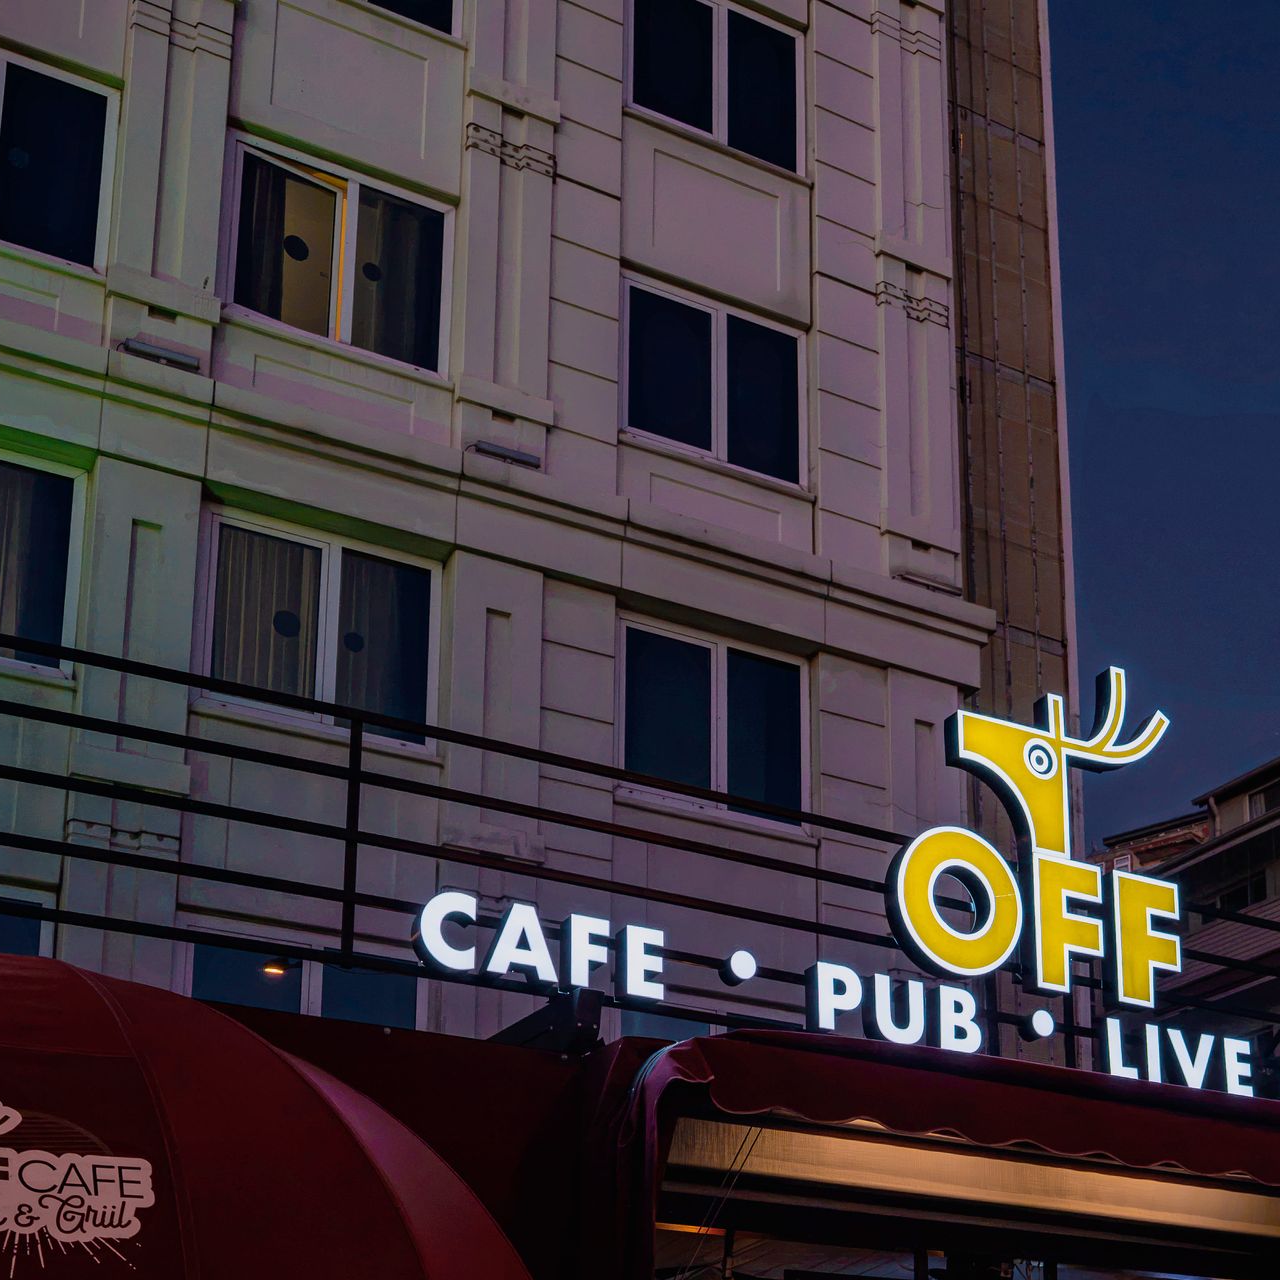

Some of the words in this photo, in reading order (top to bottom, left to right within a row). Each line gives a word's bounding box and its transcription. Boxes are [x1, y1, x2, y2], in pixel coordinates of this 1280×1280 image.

[897, 826, 1182, 1007] OFF
[419, 891, 665, 1000] CAFE
[817, 961, 984, 1054] PUB
[1106, 1017, 1254, 1098] LIVE
[14, 1204, 40, 1227] &
[18, 1160, 144, 1199] CAFE
